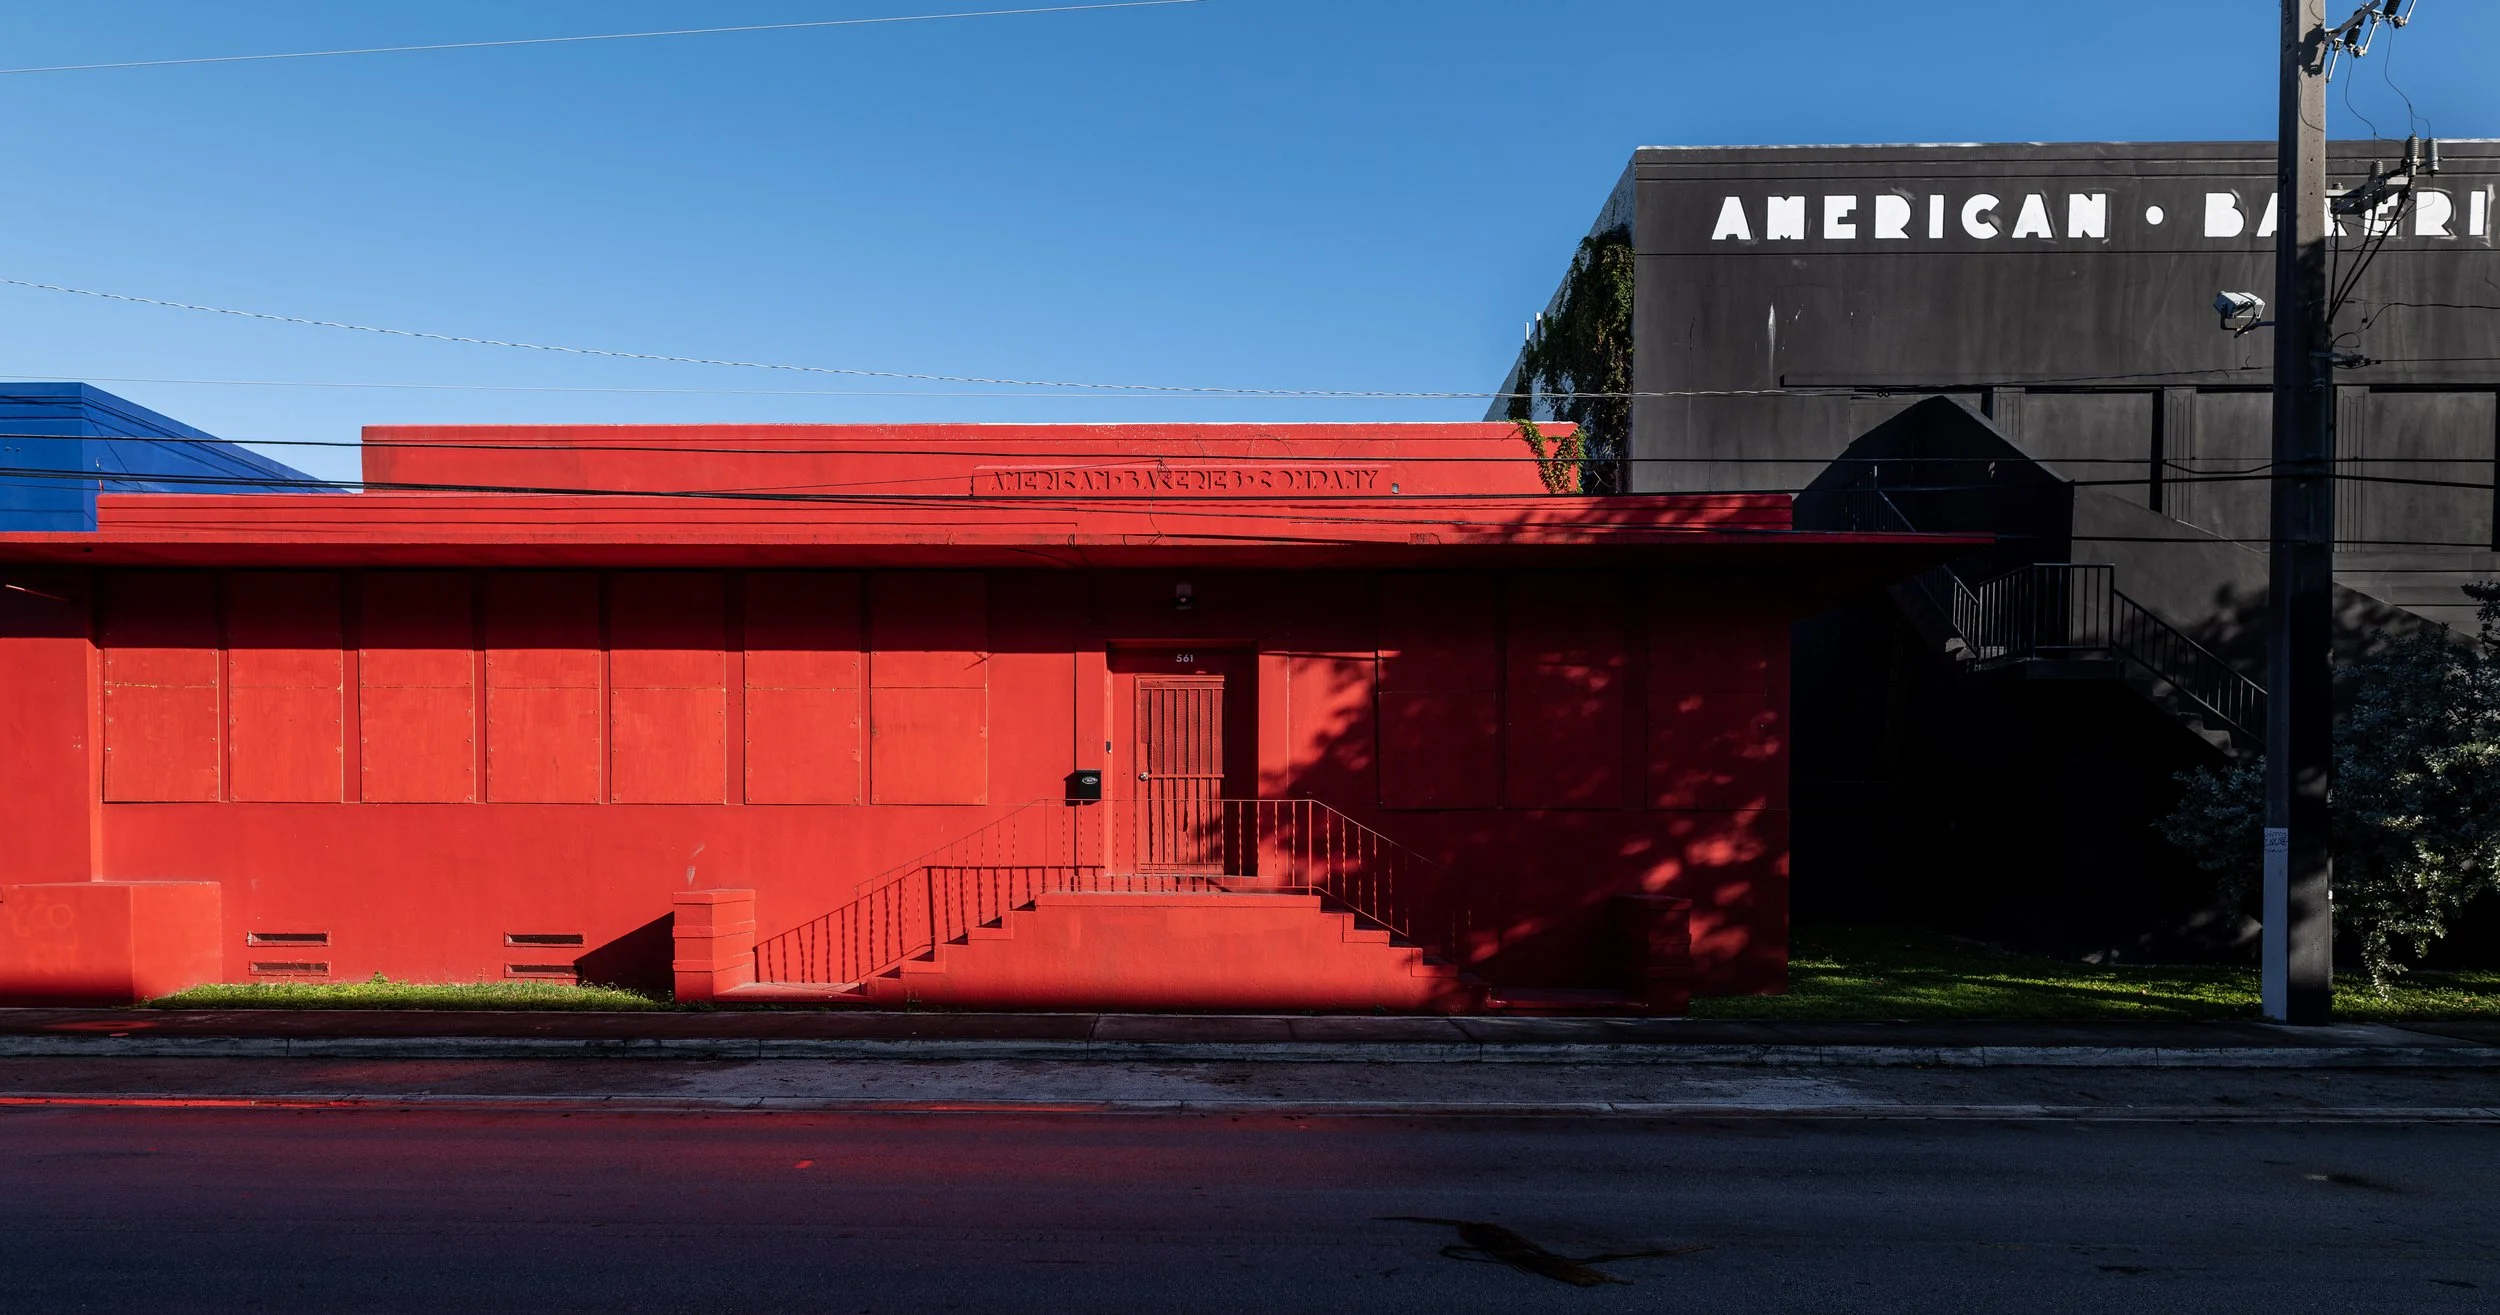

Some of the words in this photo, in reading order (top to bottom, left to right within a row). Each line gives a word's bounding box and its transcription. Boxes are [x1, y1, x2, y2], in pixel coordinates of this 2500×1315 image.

[1711, 193, 2107, 240] AMERICAN
[989, 470, 1109, 491] AMERICAN
[1123, 470, 1243, 490] BAKERIES
[1256, 470, 1379, 490] COMPANY
[1175, 653, 1194, 663] 561
